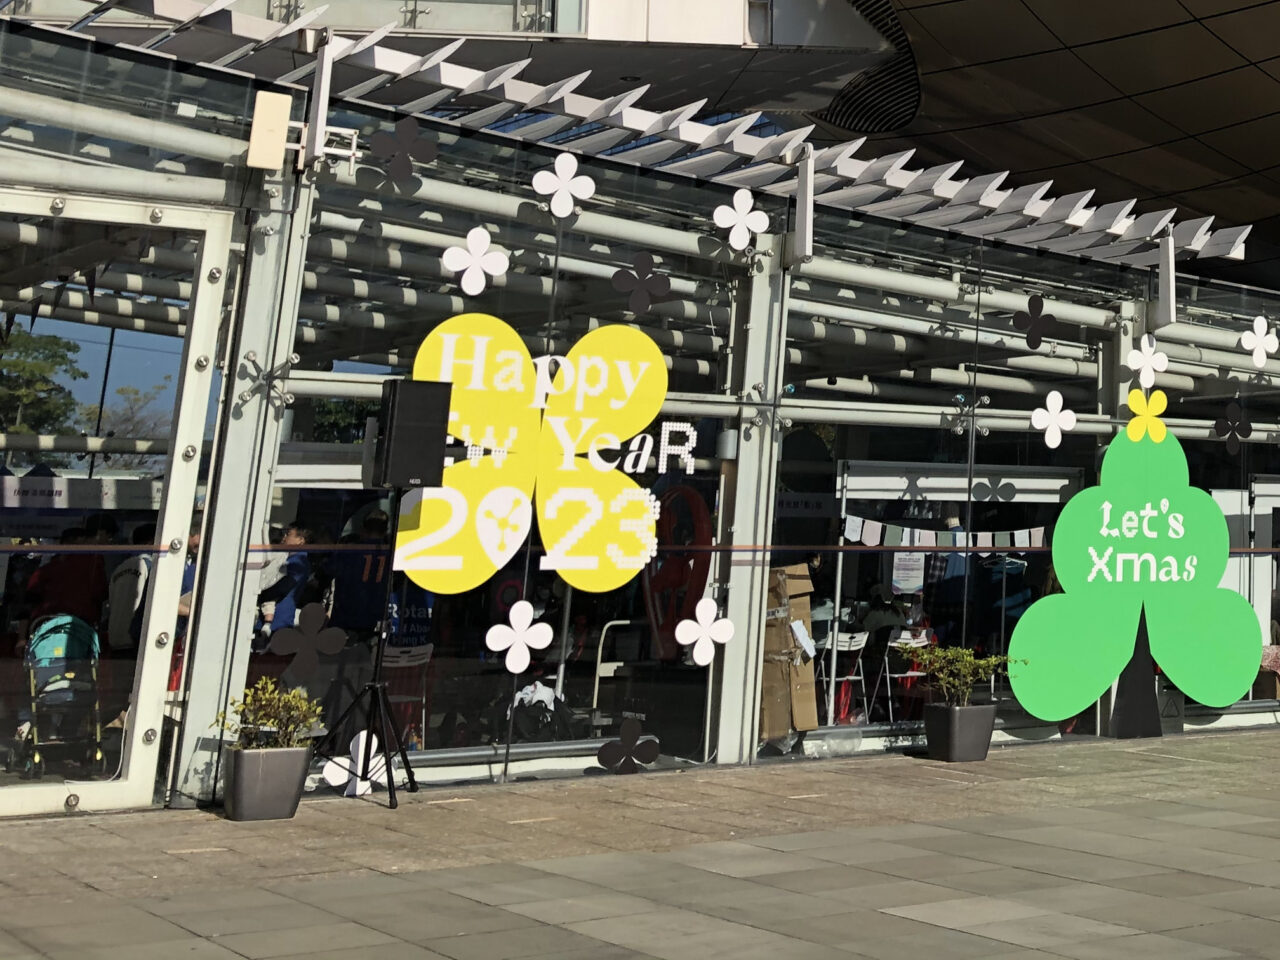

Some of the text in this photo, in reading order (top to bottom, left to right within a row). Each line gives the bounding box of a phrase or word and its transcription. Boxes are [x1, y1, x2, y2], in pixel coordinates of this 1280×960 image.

[438, 332, 651, 411] Happy
[392, 486, 661, 571] 2023
[1098, 498, 1185, 540] Let's
[1087, 546, 1198, 582] Xmas
